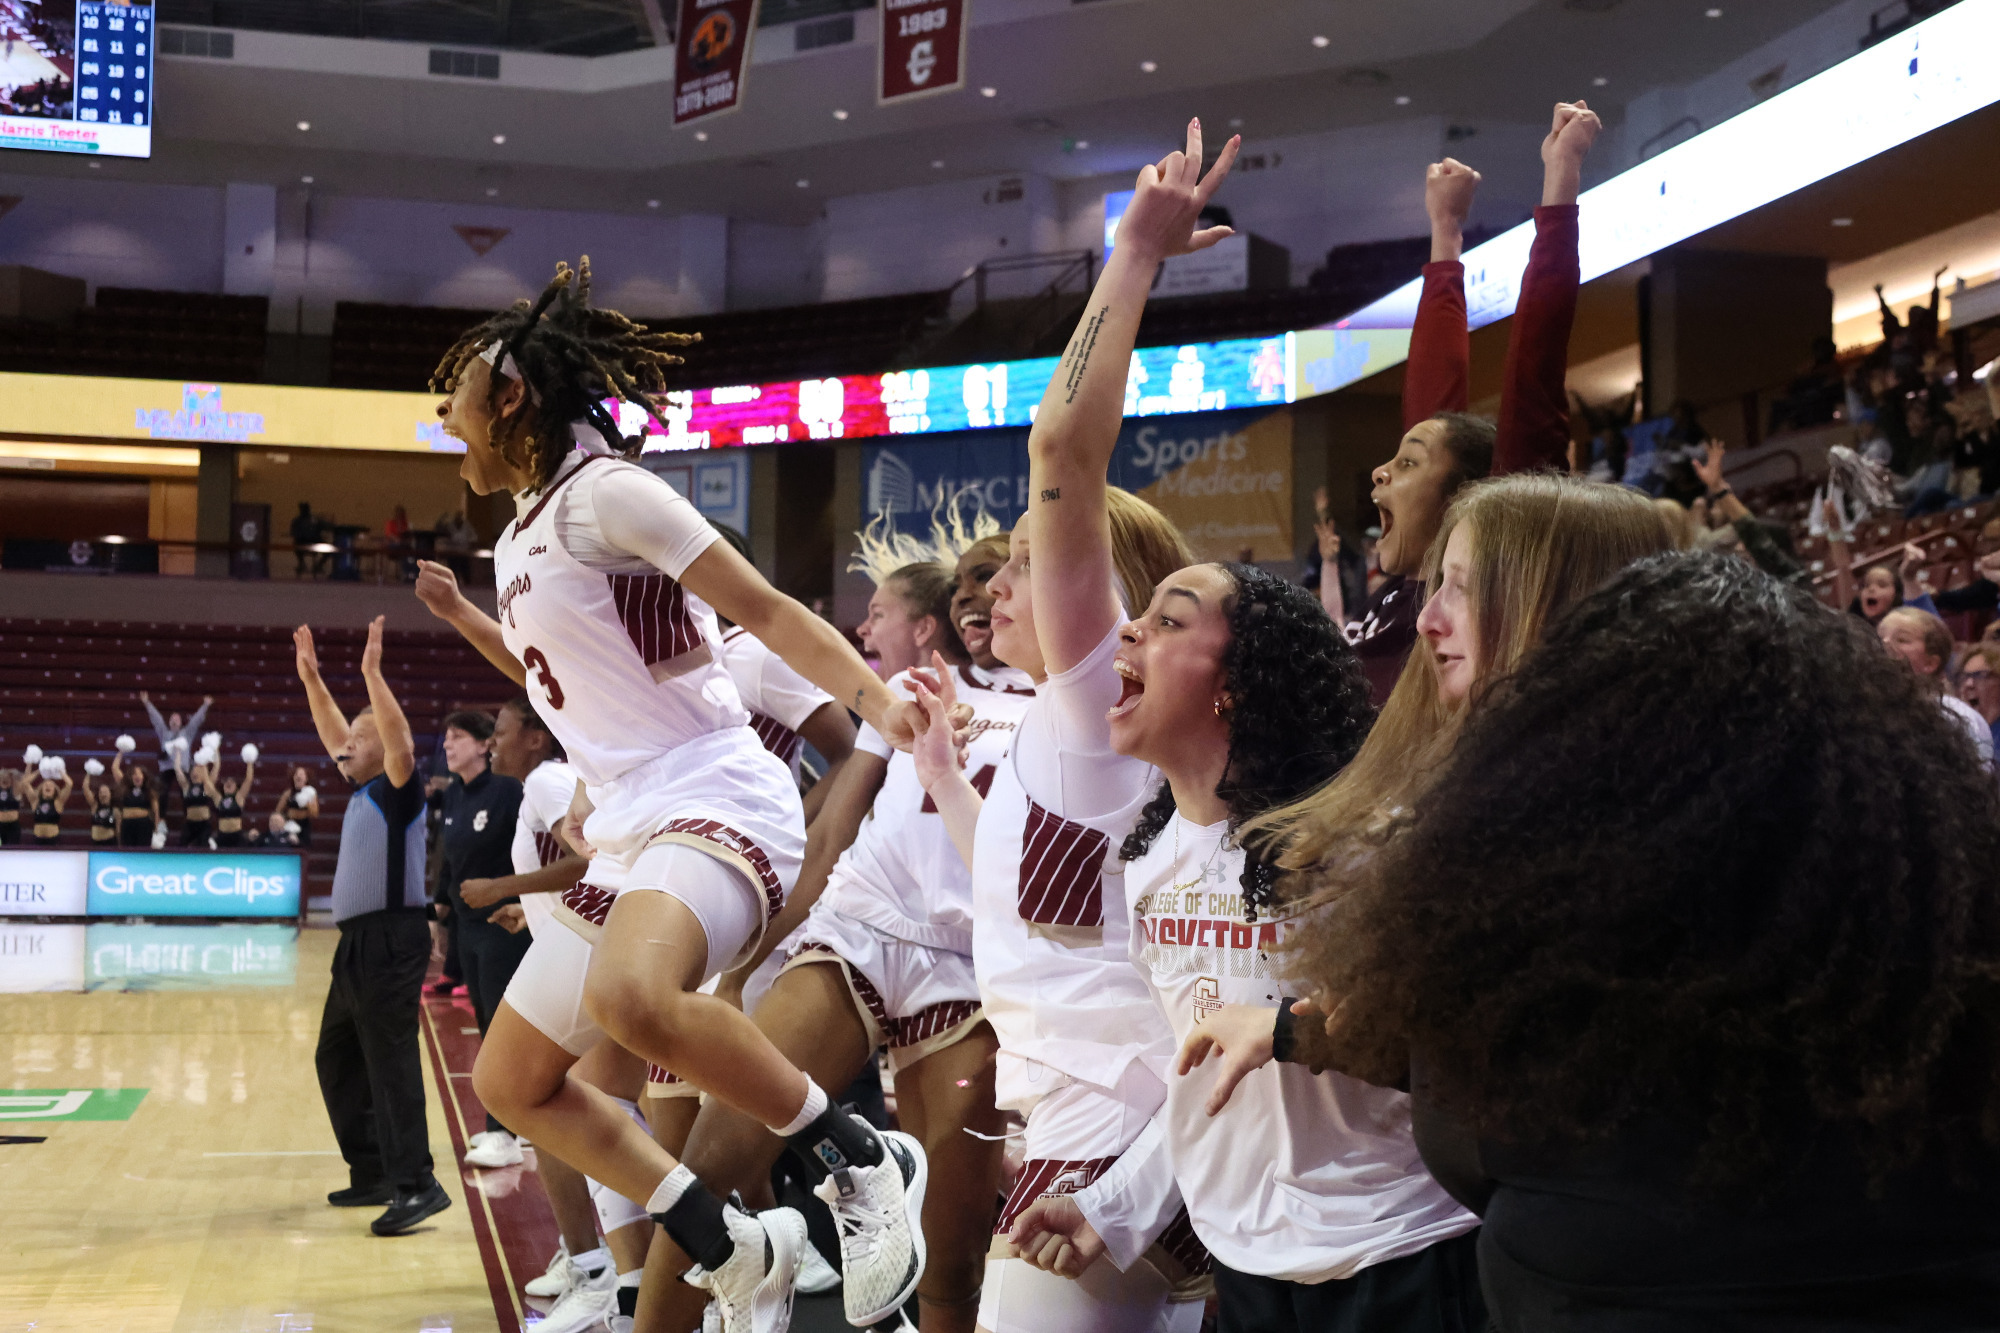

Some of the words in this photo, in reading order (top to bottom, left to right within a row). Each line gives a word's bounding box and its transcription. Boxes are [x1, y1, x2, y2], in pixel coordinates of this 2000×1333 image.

[82, 16, 99, 29] 10
[49, 124, 98, 140] Teeter
[1133, 425, 1248, 477] Sports
[1156, 465, 1283, 499] Medicine
[1041, 487, 1061, 502] 1965
[529, 545, 547, 556] CAA
[523, 645, 565, 710] 3
[96, 866, 198, 895] Great
[203, 865, 285, 903] Clips
[1185, 892, 1203, 914] OF
